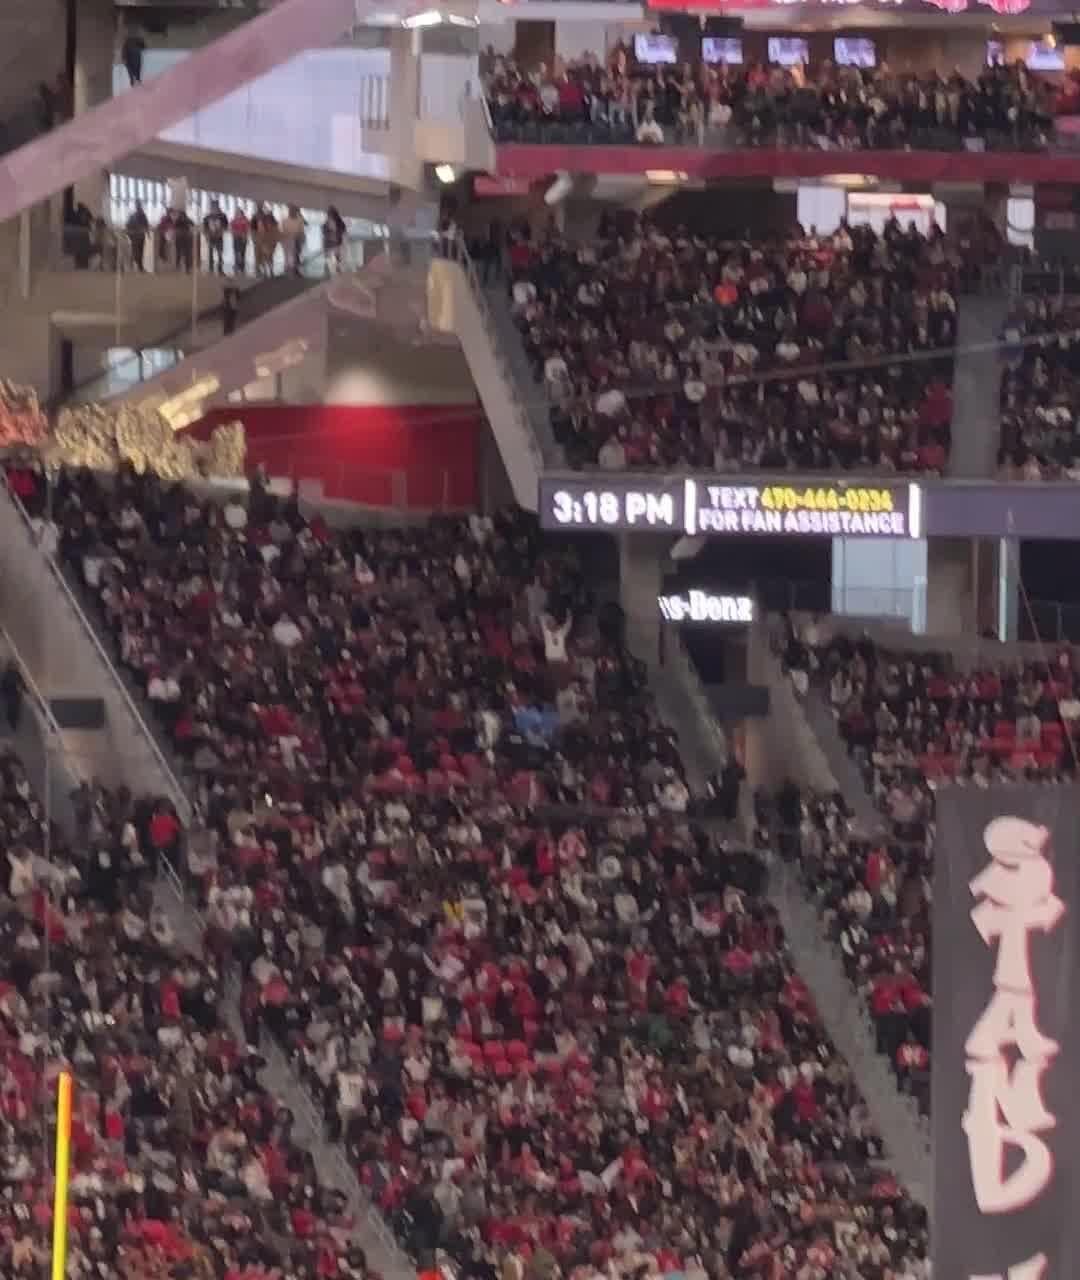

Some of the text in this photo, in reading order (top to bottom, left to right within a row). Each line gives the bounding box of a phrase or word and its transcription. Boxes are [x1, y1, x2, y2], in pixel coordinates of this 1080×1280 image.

[553, 490, 673, 525] 3:18 PM
[707, 486, 758, 510] TEXT
[700, 508, 905, 535] FOR FAN ASSISTANCE
[960, 815, 1066, 1214] STAND
